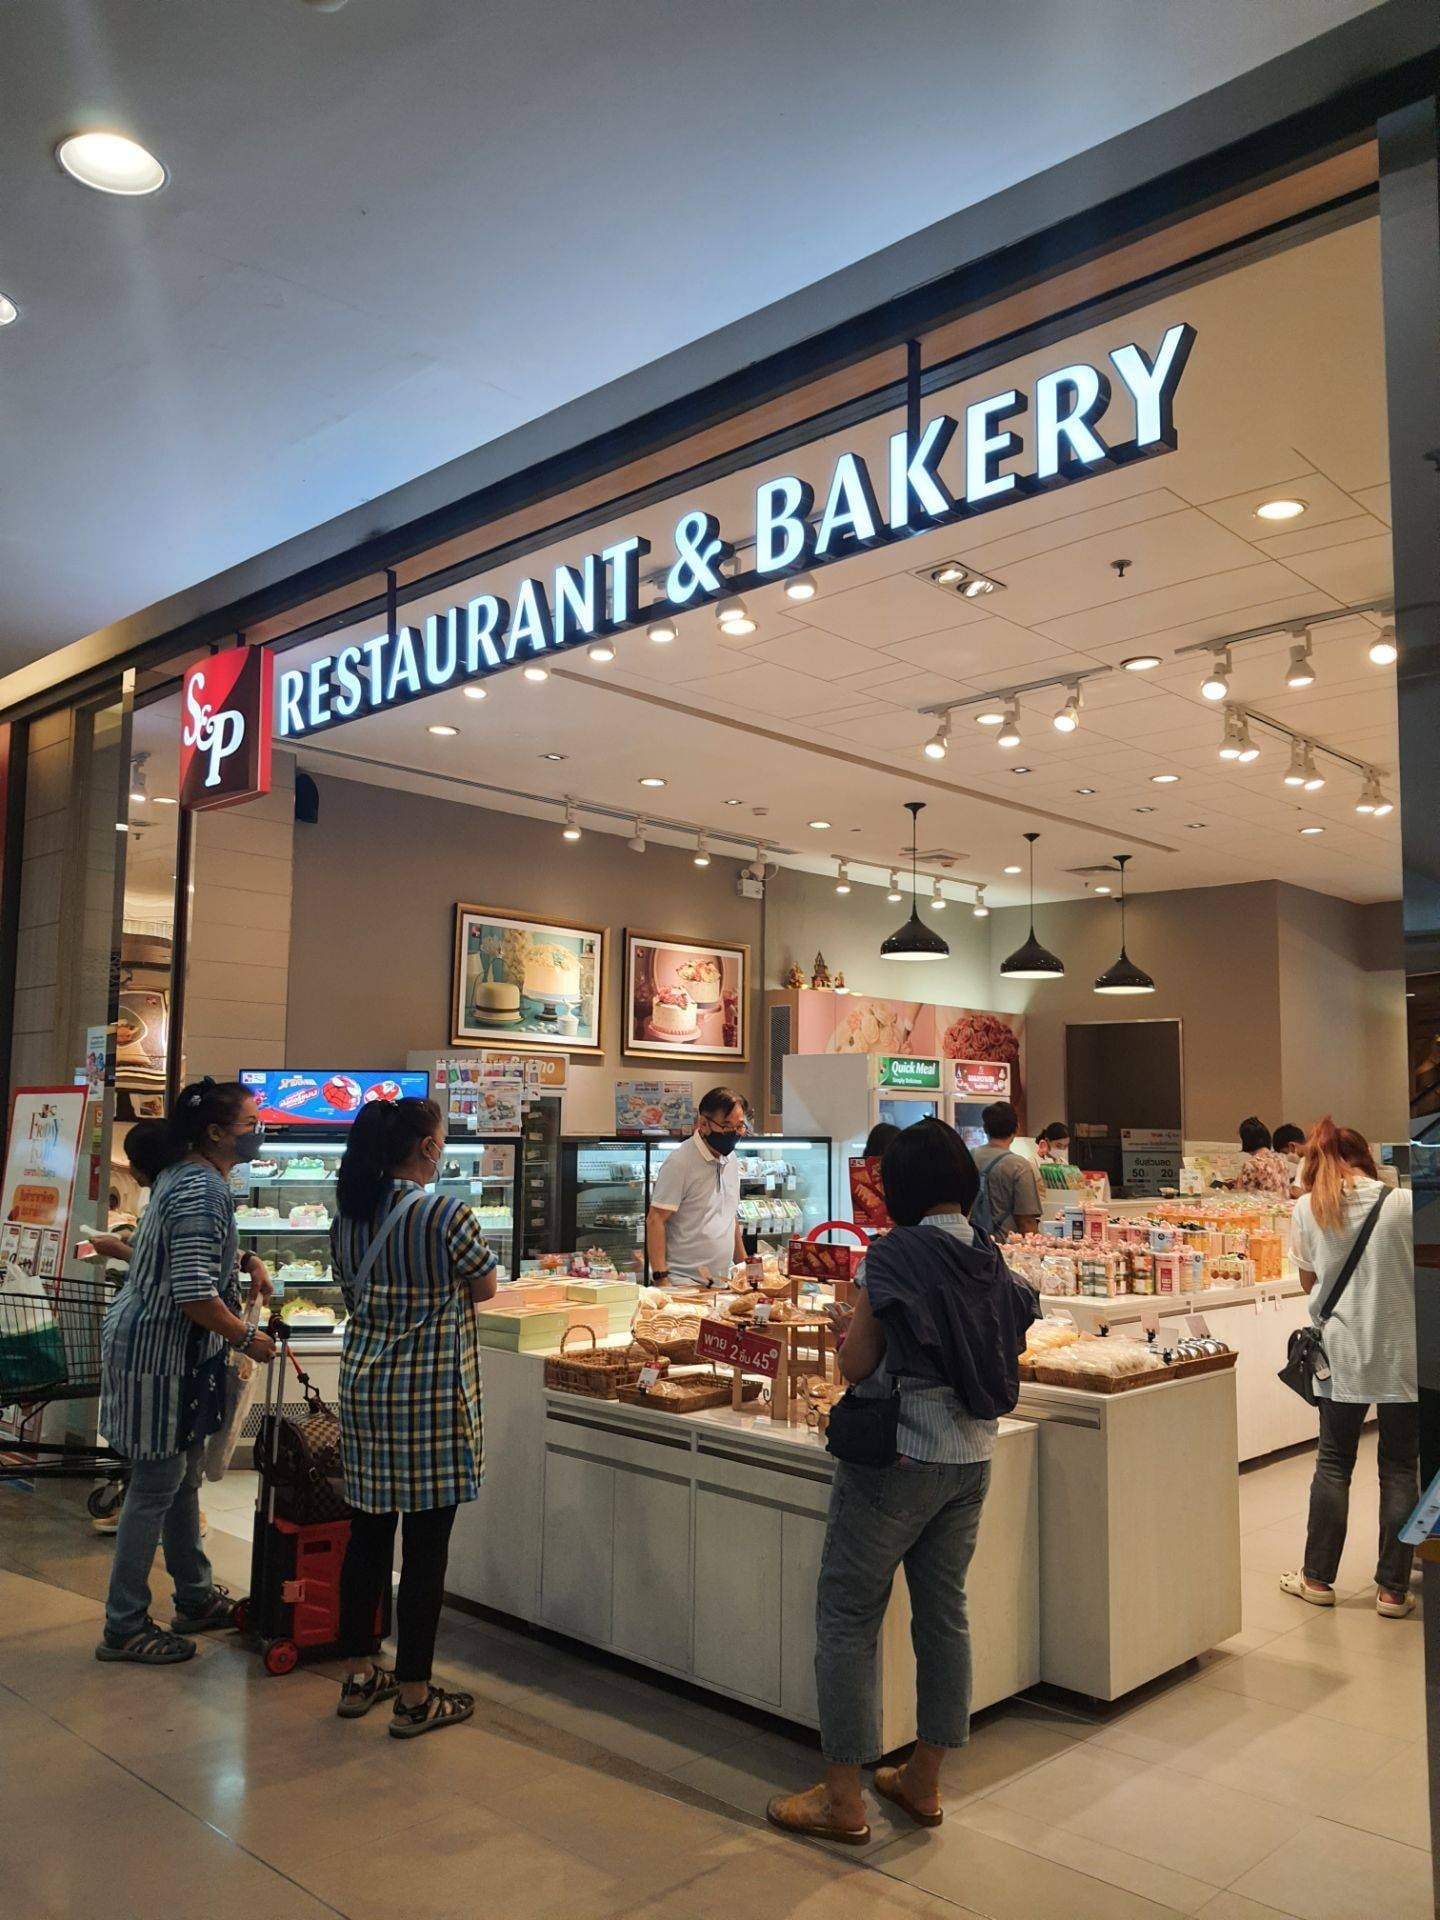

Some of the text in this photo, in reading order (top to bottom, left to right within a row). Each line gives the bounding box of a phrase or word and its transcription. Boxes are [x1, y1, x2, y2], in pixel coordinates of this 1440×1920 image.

[280, 322, 1190, 736] RESTAURANT & BAKERY
[183, 672, 246, 787] S&P
[891, 1060, 936, 1077] Quick Meal
[1132, 1168, 1145, 1178] 50
[1161, 1168, 1174, 1178] 20
[704, 1333, 727, 1350] พาย
[729, 1344, 738, 1360] 2
[752, 1352, 770, 1370] 45
